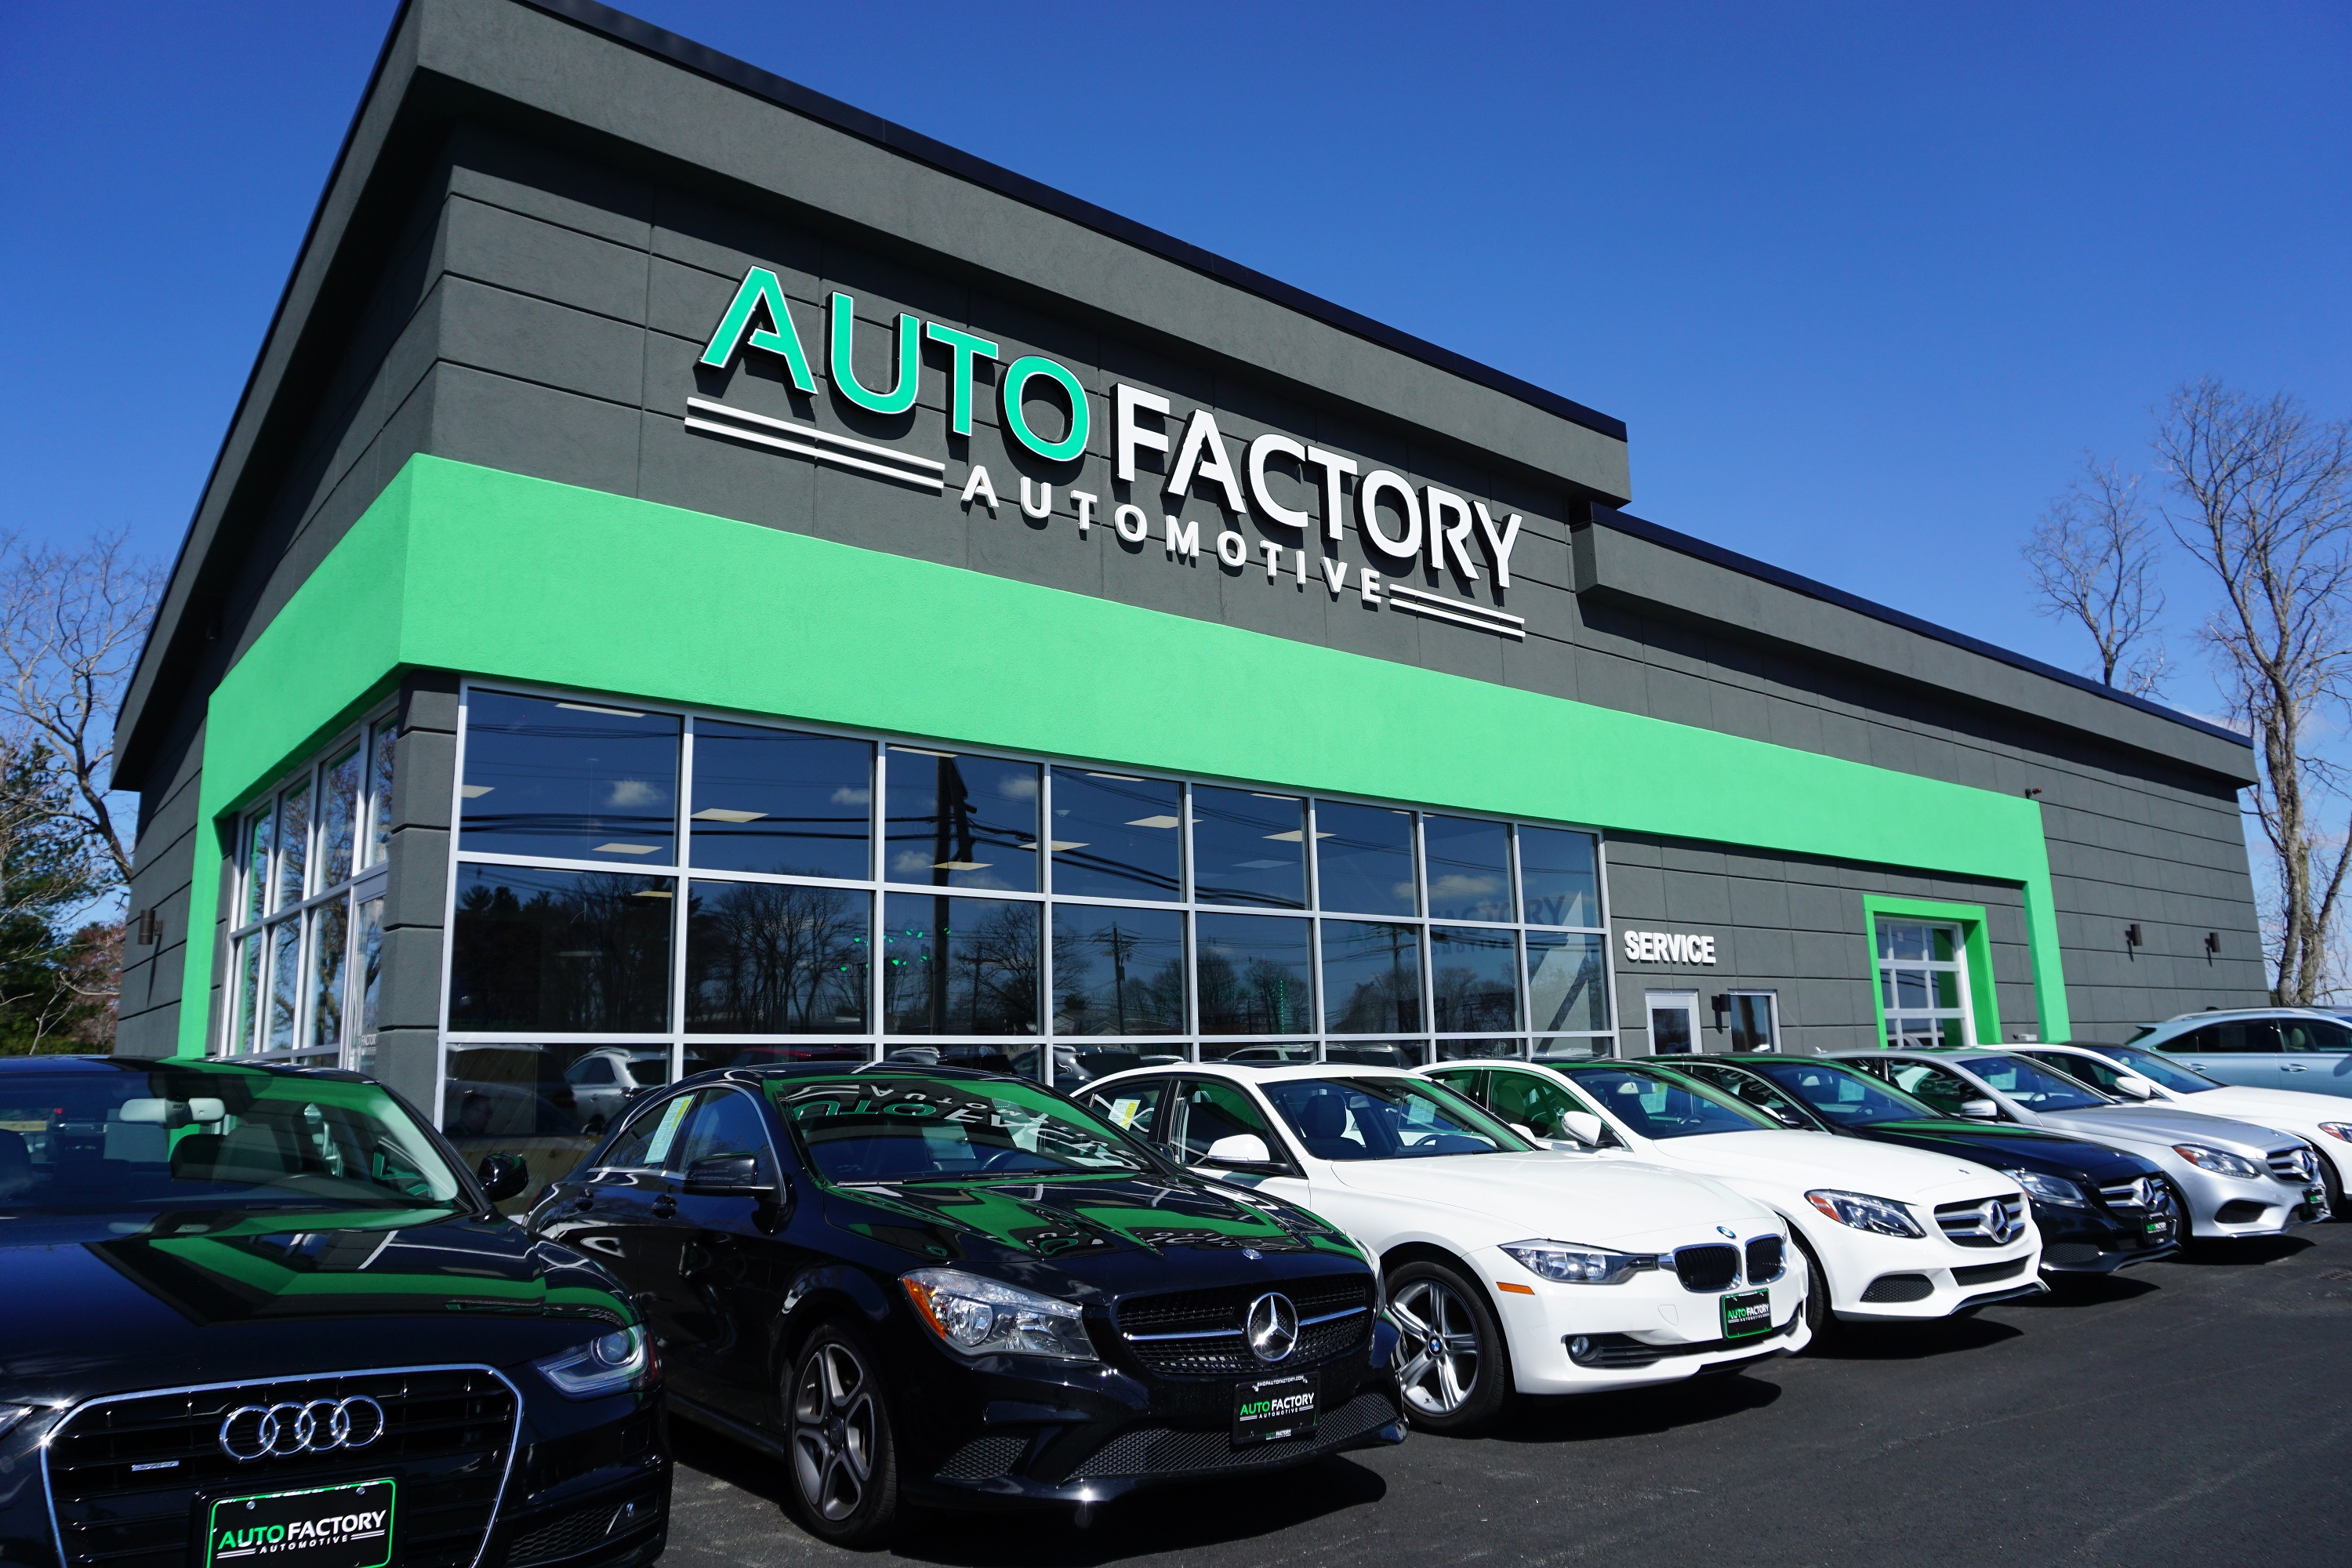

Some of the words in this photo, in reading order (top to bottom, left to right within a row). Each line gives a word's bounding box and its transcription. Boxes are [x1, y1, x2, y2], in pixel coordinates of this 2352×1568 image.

[700, 265, 1091, 462] AUTO
[1114, 382, 1523, 590] FACTORY
[960, 464, 1381, 604] AUTOMOTIVE
[1624, 930, 1716, 964] SERVICE
[1727, 1308, 1747, 1319] AUTO
[1745, 1303, 1769, 1316] FACTORY
[1240, 1401, 1271, 1416] AUTO
[1271, 1392, 1315, 1411] FACTORY
[1258, 1407, 1298, 1419] AUTOMOTIVE
[217, 1525, 285, 1550] AUTO
[287, 1509, 387, 1541] FACTORY
[259, 1534, 349, 1555] AUTOMOTIVE
